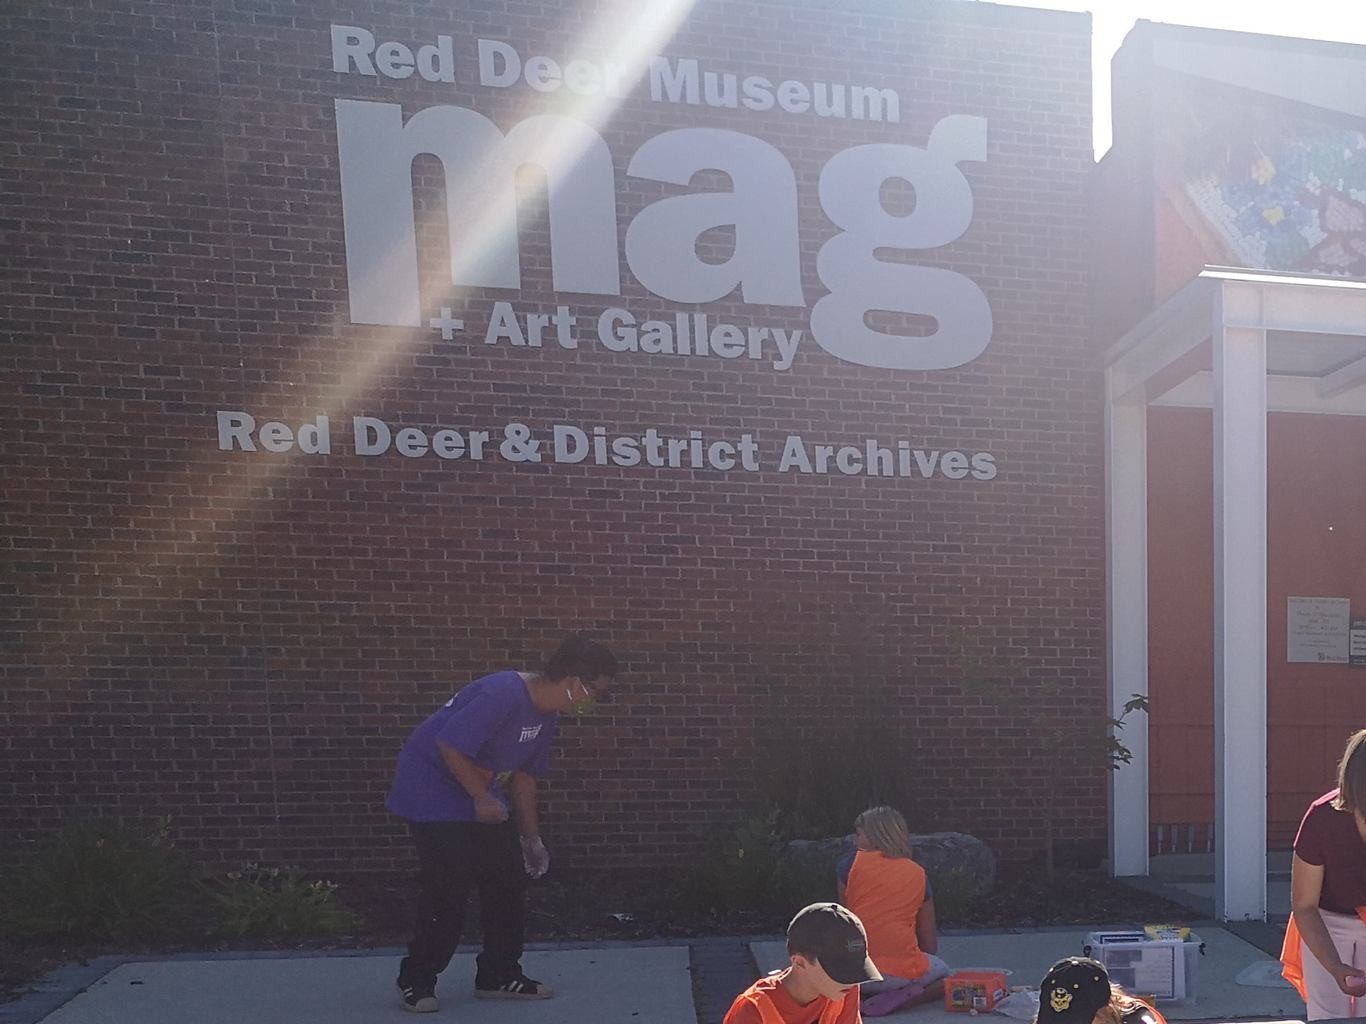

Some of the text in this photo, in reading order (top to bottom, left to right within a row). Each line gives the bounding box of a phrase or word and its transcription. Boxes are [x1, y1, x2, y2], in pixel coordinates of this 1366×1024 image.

[331, 24, 901, 125] Red Deer Museum
[334, 98, 994, 371] mag
[485, 302, 579, 351] Art
[599, 307, 804, 371] Gallery
[217, 410, 998, 482] Red Deer & District Archives
